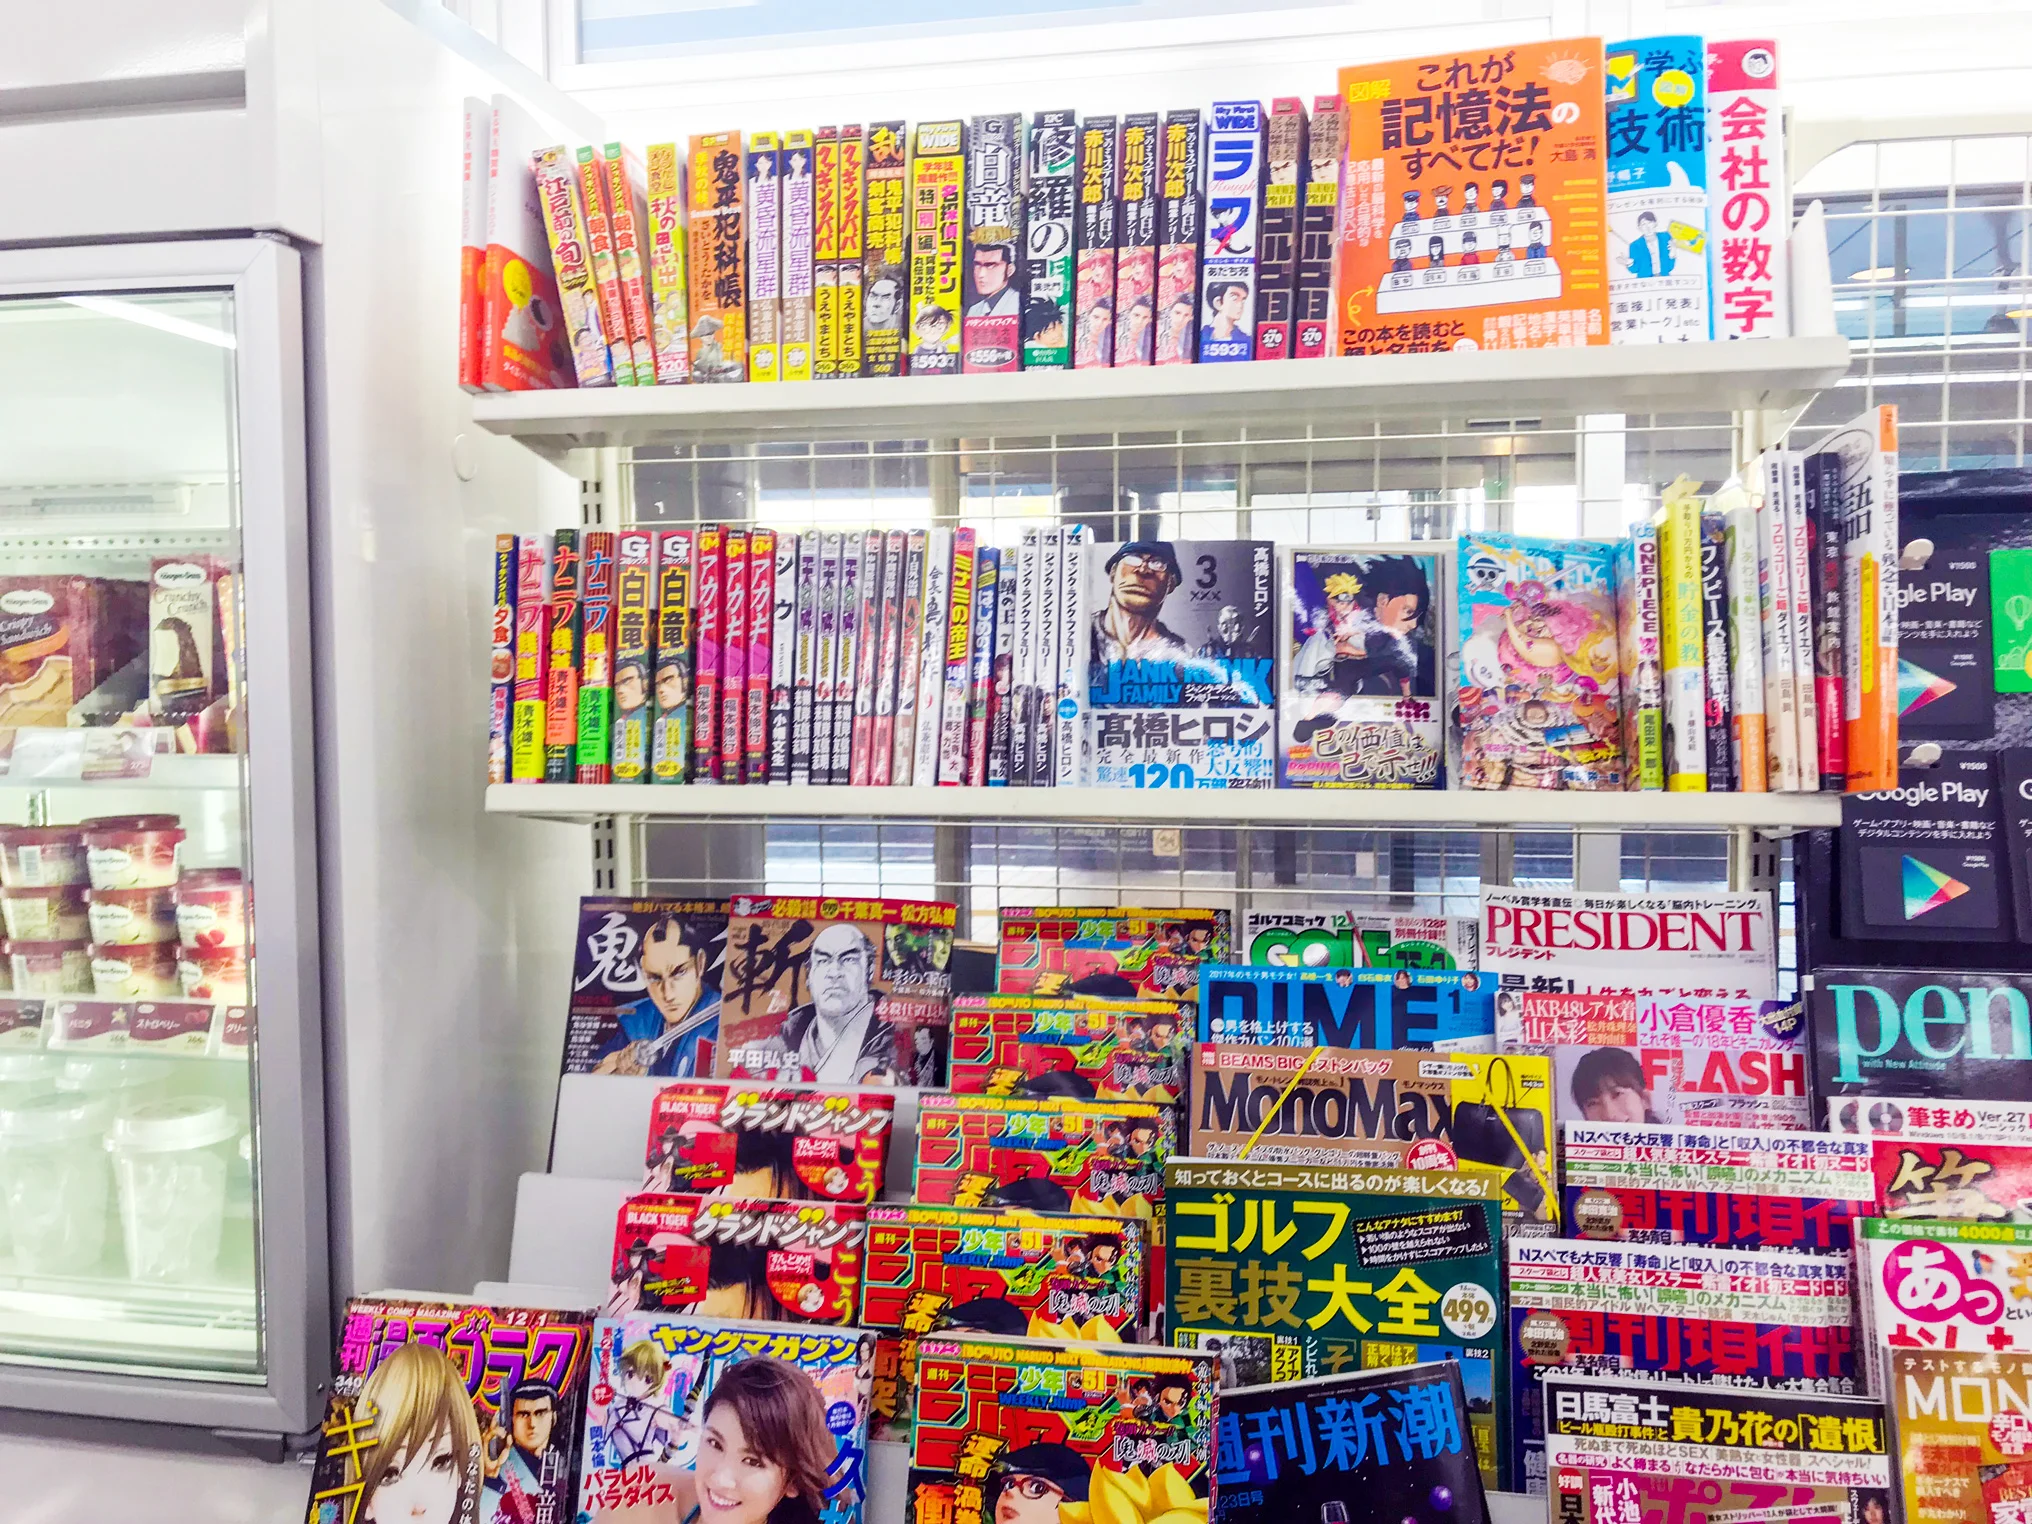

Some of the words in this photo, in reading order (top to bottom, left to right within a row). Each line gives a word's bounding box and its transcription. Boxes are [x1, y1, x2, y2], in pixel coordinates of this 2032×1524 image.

[1416, 51, 1516, 92] これが
[1644, 49, 1703, 75] 学ぶ
[1350, 79, 1391, 101] 図解
[1215, 114, 1257, 130] WIDE
[1380, 82, 1581, 150] 記憶法の
[1607, 105, 1712, 157] 技術
[920, 133, 959, 148] WIDE
[1083, 129, 1104, 203] 赤川次郎
[1123, 126, 1145, 201] 赤川次郎
[1402, 136, 1540, 180] すべてだ!
[543, 175, 586, 265] 江戸前の旬
[711, 150, 743, 310] 鬼平犯科帳
[1720, 96, 1774, 333] 会社の数字
[755, 183, 777, 299] 黄昏流星群
[789, 181, 812, 298] 黄昏流星群
[939, 184, 959, 294] 名探偵コナン
[1208, 266, 1250, 278] あだち充
[818, 288, 832, 359] うえやまとち
[842, 287, 856, 358] うえやまとち
[1343, 320, 1466, 346] この本を読むと
[620, 535, 649, 557] G
[662, 535, 690, 557] G
[1196, 554, 1218, 589] 3
[618, 567, 649, 650] 白竜
[658, 566, 690, 650] 白竜
[948, 553, 973, 660] ミナミの帝王
[1896, 583, 1928, 608] gle
[1929, 582, 1978, 608] Play
[493, 608, 511, 645] 夕食
[1121, 683, 1184, 704] FAMILY
[1096, 748, 1205, 765] 完全最新作
[1204, 758, 1273, 778] 大反響!!
[1128, 763, 1195, 789] 120
[1941, 781, 1990, 808] Play
[839, 901, 898, 921] 千葉真一
[900, 904, 957, 928] 松方弘樹
[1248, 912, 1328, 928] ゴルフコミック
[1485, 905, 1764, 952] PRESIDENT
[573, 912, 648, 993] 鬼
[1485, 947, 1557, 962] プレジデント
[1208, 980, 1440, 1052] DIME
[1524, 998, 1637, 1022] AKB48レア水着
[1641, 1002, 1757, 1035] 小倉優香
[1525, 1019, 1588, 1045] 山本彩
[1826, 984, 2032, 1083] pen
[727, 1049, 801, 1070] 平田弘史
[1219, 1053, 1276, 1071] BEAMS
[1640, 1048, 1807, 1097] FLASH
[720, 1092, 894, 1136] グランドジャンプ
[1199, 1071, 1453, 1145] MonoMax
[1907, 1106, 1976, 1130] 筆まめ
[1978, 1111, 2026, 1124] Ver.27
[1174, 1168, 1490, 1199] 知っておくとコースに出るのが楽しくなる!
[626, 1211, 659, 1225] BLACK
[661, 1214, 689, 1228] TIGER
[692, 1202, 867, 1249] グランドジャンプ
[1174, 1192, 1352, 1262] ゴルフ
[963, 1228, 1006, 1251] 少年
[1174, 1256, 1444, 1338] 裏技大全
[1897, 1245, 1998, 1318] あっ
[351, 1304, 385, 1315] WEEKLY
[387, 1306, 416, 1317] COMIC
[416, 1308, 462, 1320] MAGAZINE
[506, 1312, 548, 1328] 12/1
[1443, 1299, 1490, 1324] 499
[651, 1324, 858, 1364] ヤングマガジン
[335, 1376, 362, 1388] 340
[927, 1368, 949, 1382] 週刊
[1019, 1366, 1066, 1396] 少年
[1081, 1368, 1106, 1391] 51
[1556, 1391, 1671, 1428] 日馬富士
[1670, 1405, 1886, 1455] 貴乃花の「遺恨」
[584, 1464, 656, 1492] パラレル
[1558, 1474, 1584, 1490] 好調
[584, 1484, 677, 1512] パラダイス
[1616, 1477, 1641, 1523] 小池
